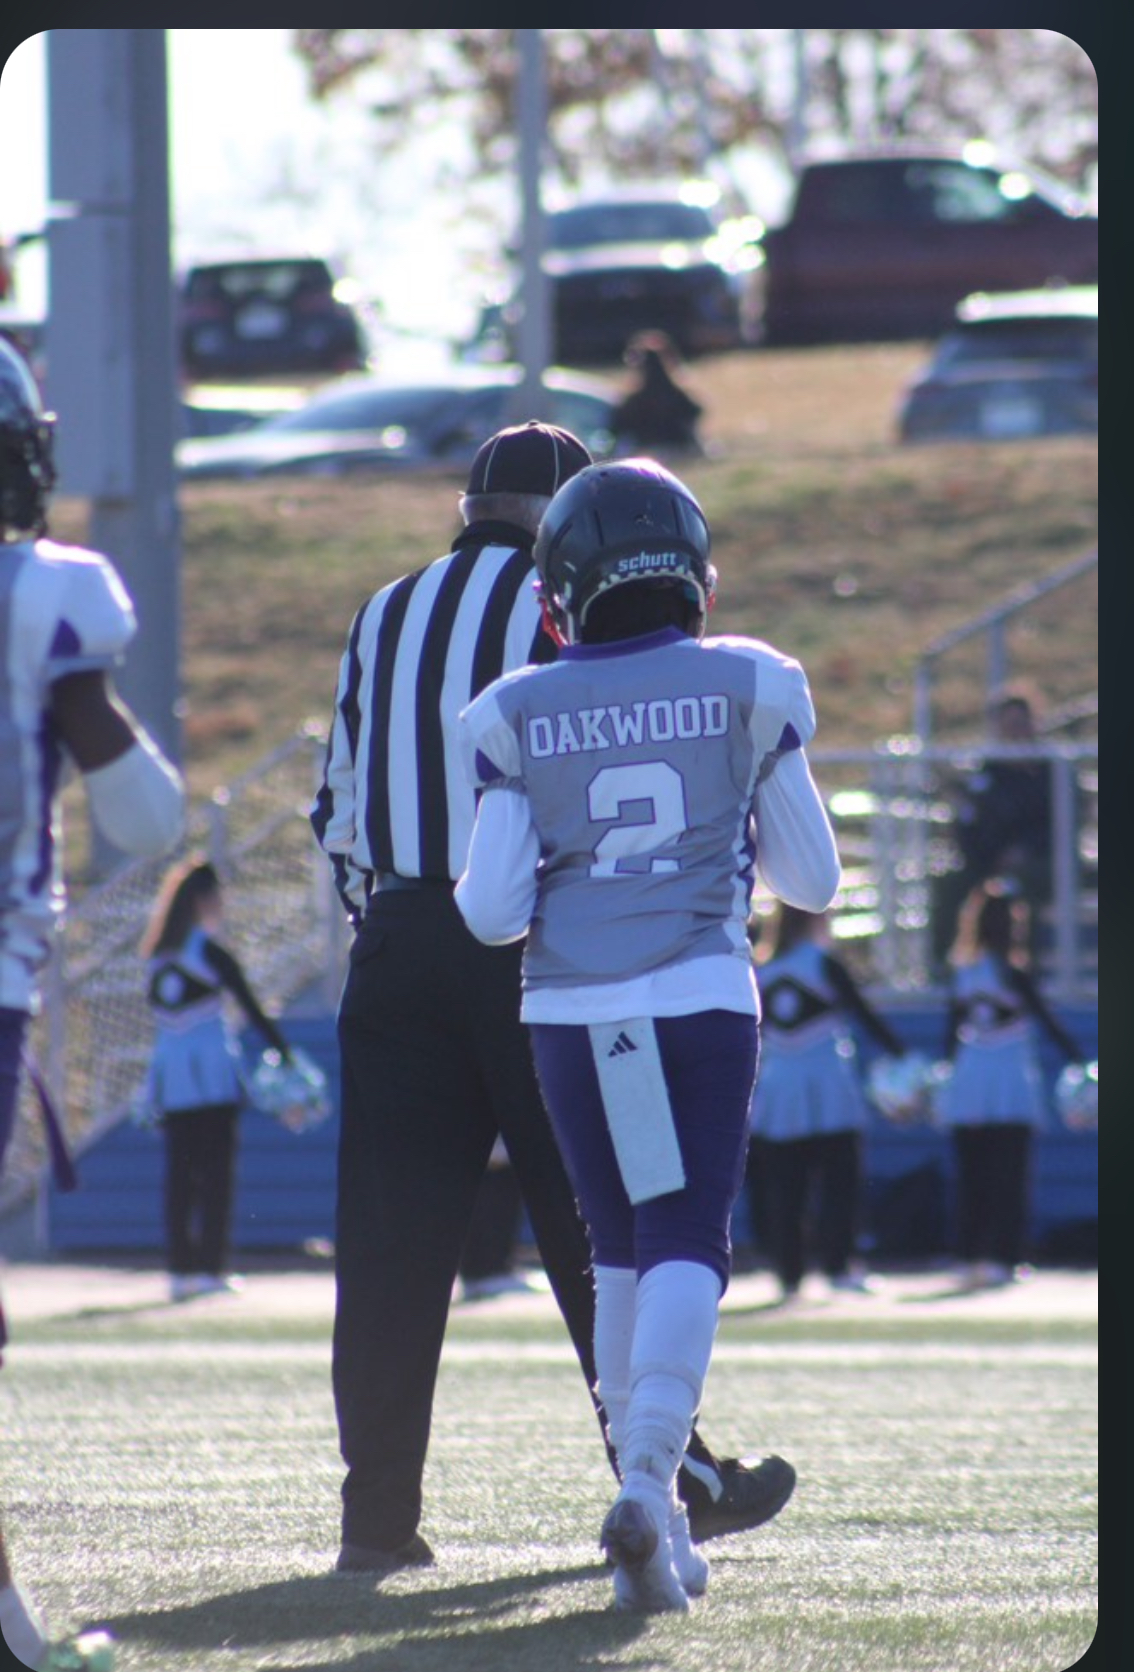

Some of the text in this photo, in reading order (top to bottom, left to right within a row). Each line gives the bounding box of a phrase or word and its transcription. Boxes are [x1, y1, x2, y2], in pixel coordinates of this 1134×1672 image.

[618, 551, 677, 572] schutt
[529, 695, 729, 758] OAKWOOD
[587, 760, 686, 877] 2
